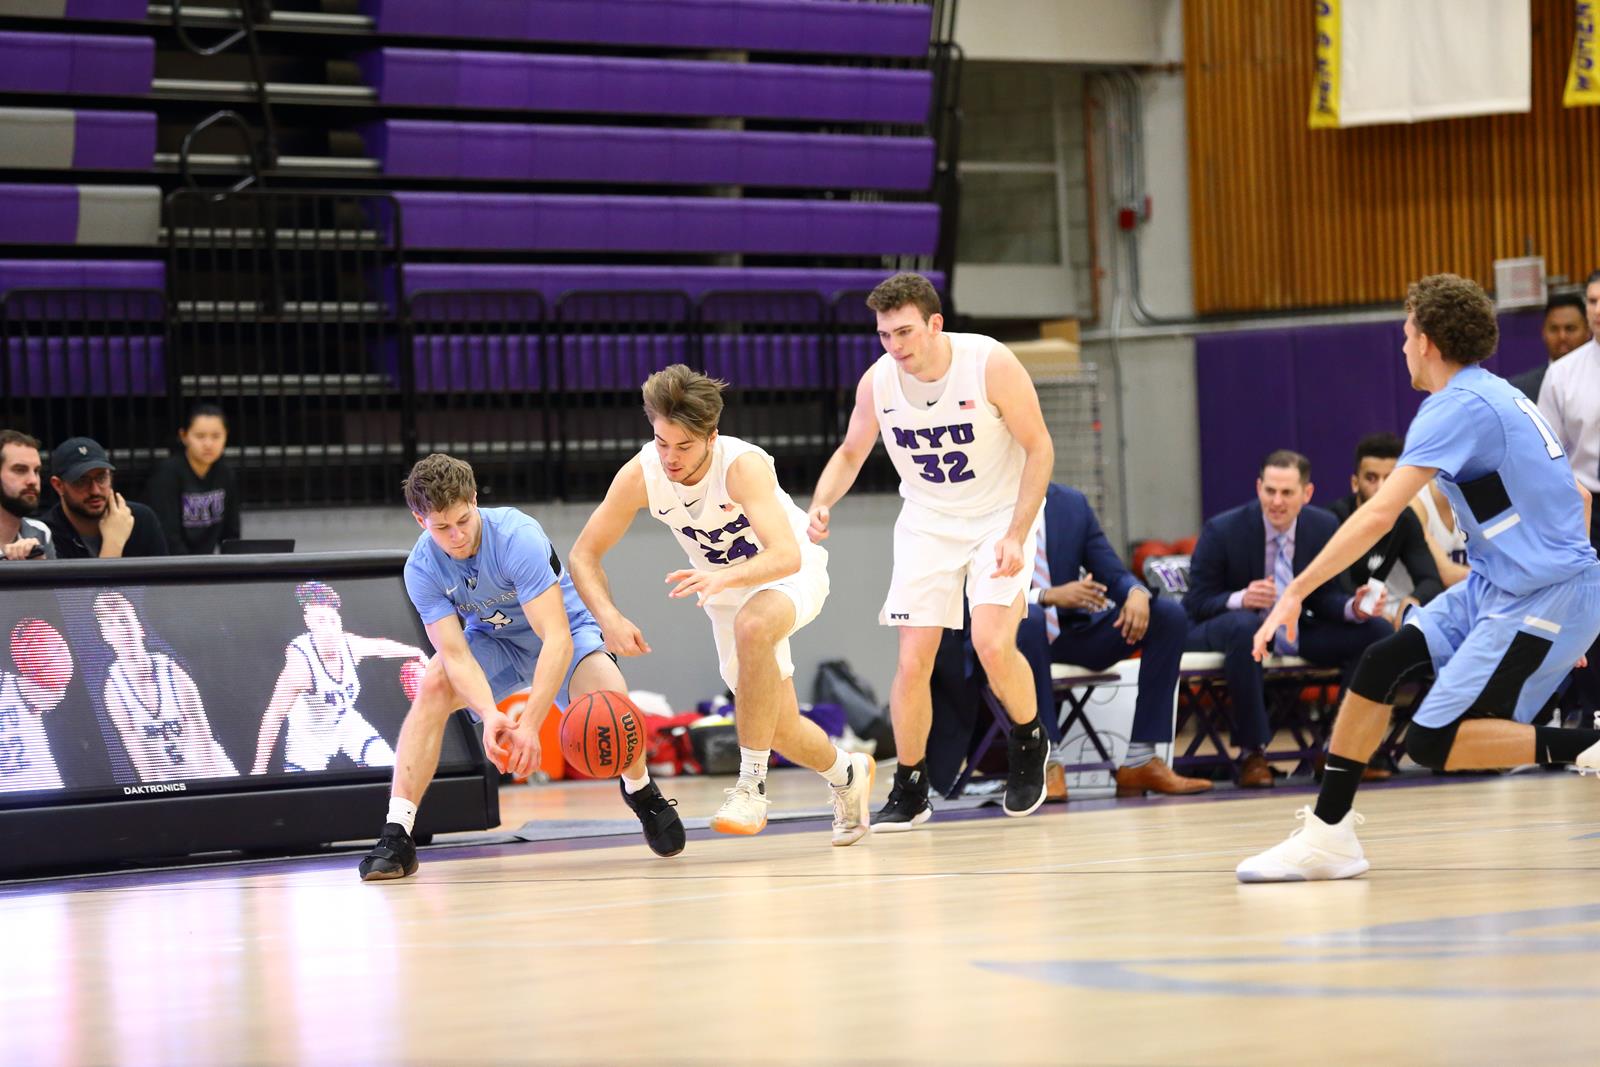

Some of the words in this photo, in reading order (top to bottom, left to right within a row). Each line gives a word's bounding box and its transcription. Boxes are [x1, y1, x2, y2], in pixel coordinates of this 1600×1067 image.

[892, 423, 975, 449] NYU
[911, 451, 976, 483] 32
[182, 490, 225, 521] NYU
[597, 725, 612, 767] NCAA
[620, 711, 639, 769] Wilson
[124, 783, 187, 795] DAKTRONICS
